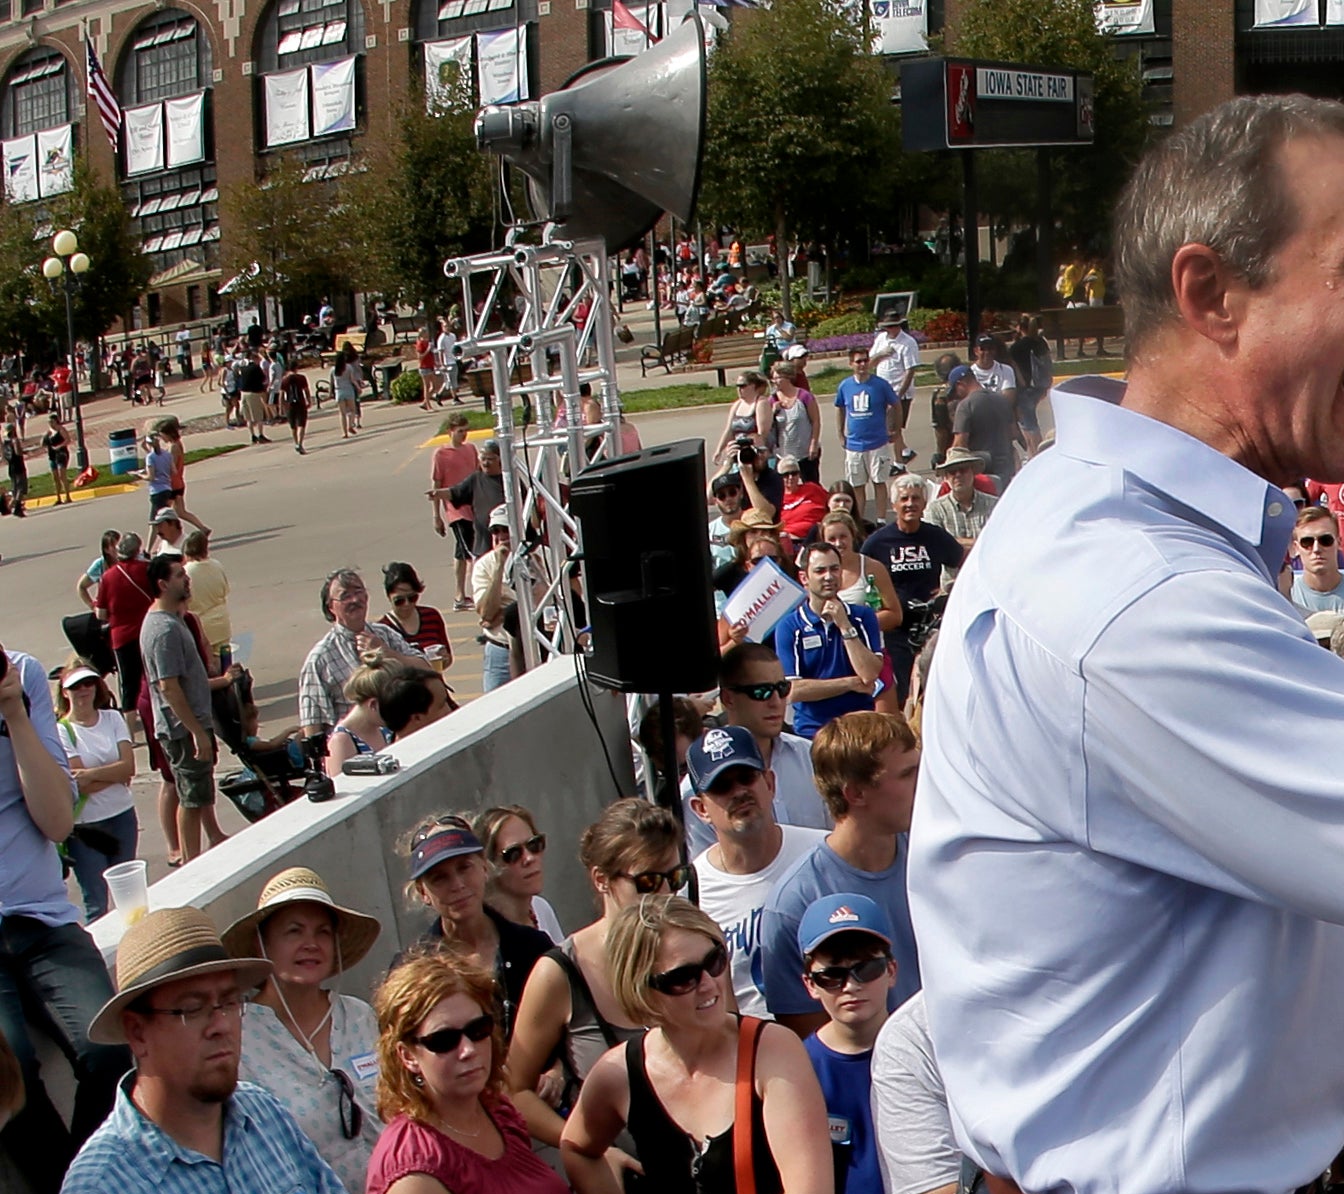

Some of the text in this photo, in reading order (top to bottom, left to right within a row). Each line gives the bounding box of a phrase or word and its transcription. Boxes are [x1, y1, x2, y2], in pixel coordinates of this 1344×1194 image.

[985, 70, 1068, 98] IOWA STATE FAIR
[890, 546, 930, 564] USA
[891, 562, 924, 572] SOCCER
[740, 579, 782, 627] O'MALLEY
